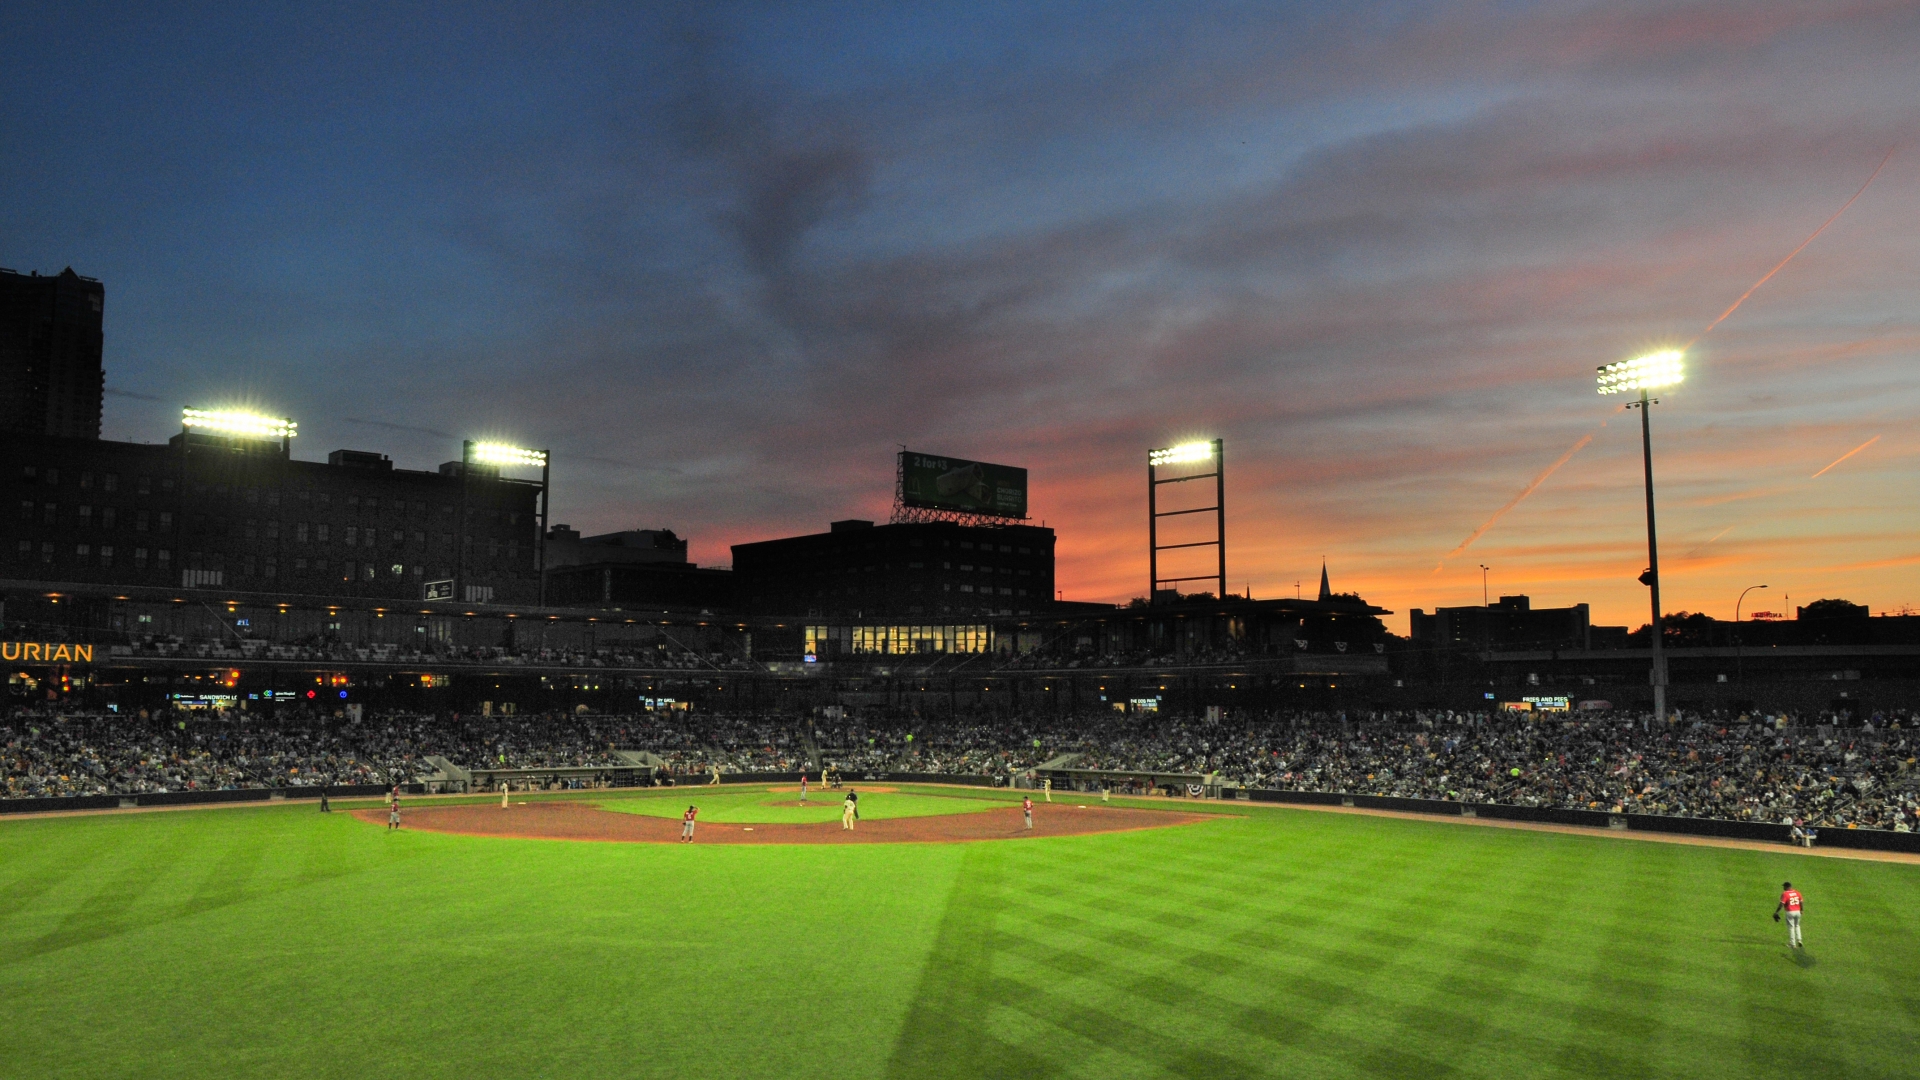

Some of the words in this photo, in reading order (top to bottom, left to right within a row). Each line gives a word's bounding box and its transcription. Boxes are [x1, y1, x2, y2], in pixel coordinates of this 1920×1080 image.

[914, 456, 921, 467] 2
[922, 457, 937, 469] for
[937, 459, 948, 471] $3
[2, 642, 93, 662] URIAN
[1789, 896, 1800, 906] 25
